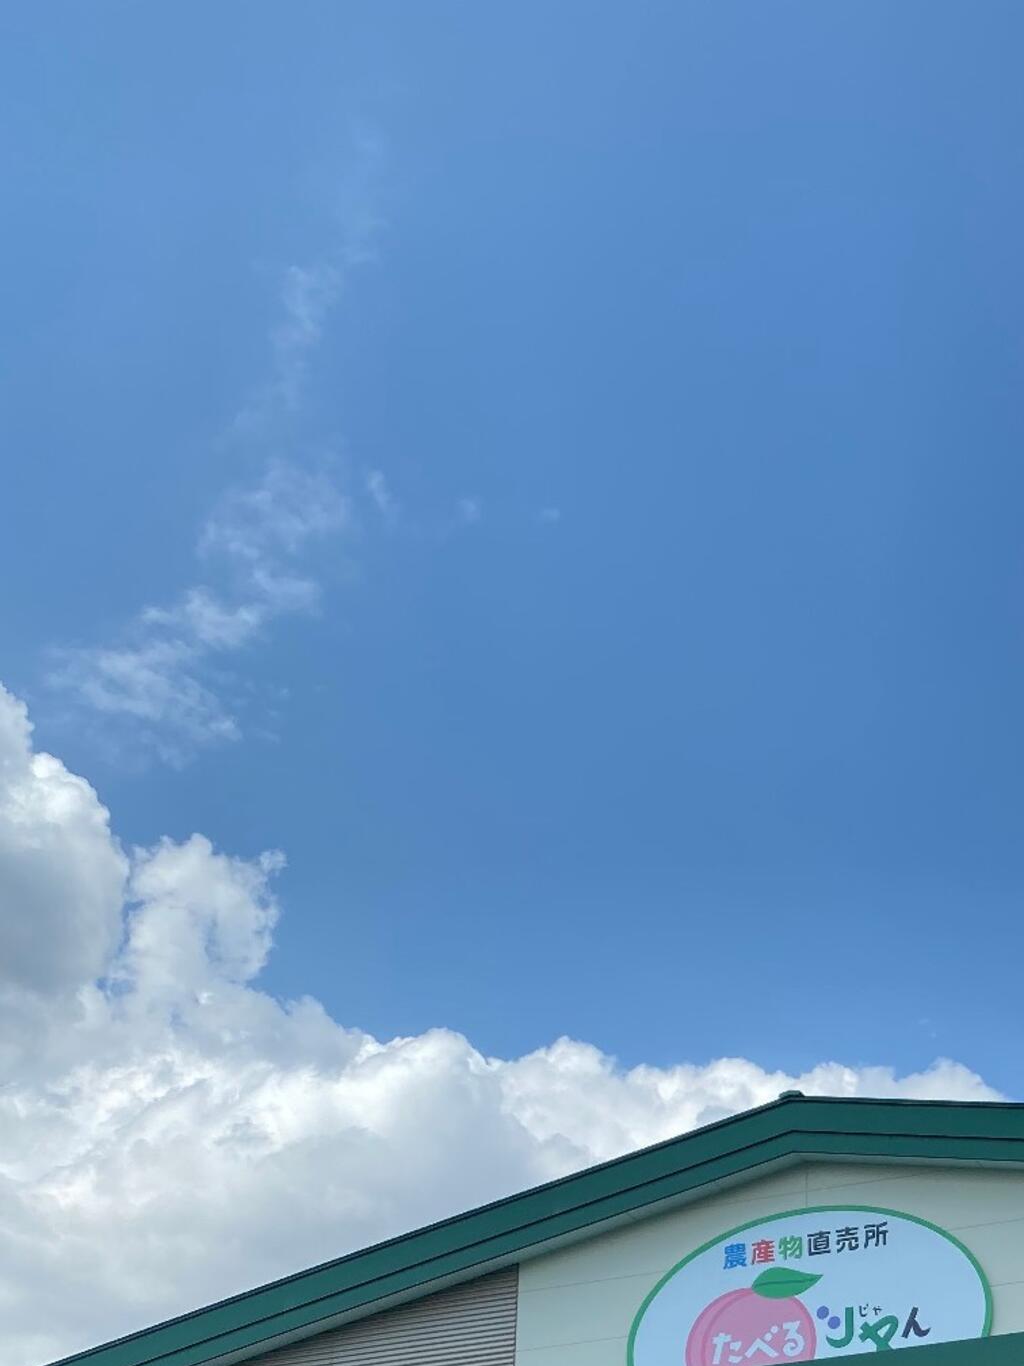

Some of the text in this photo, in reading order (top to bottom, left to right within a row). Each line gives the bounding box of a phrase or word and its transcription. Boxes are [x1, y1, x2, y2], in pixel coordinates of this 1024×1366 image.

[723, 1221, 889, 1270] 農産物直売所
